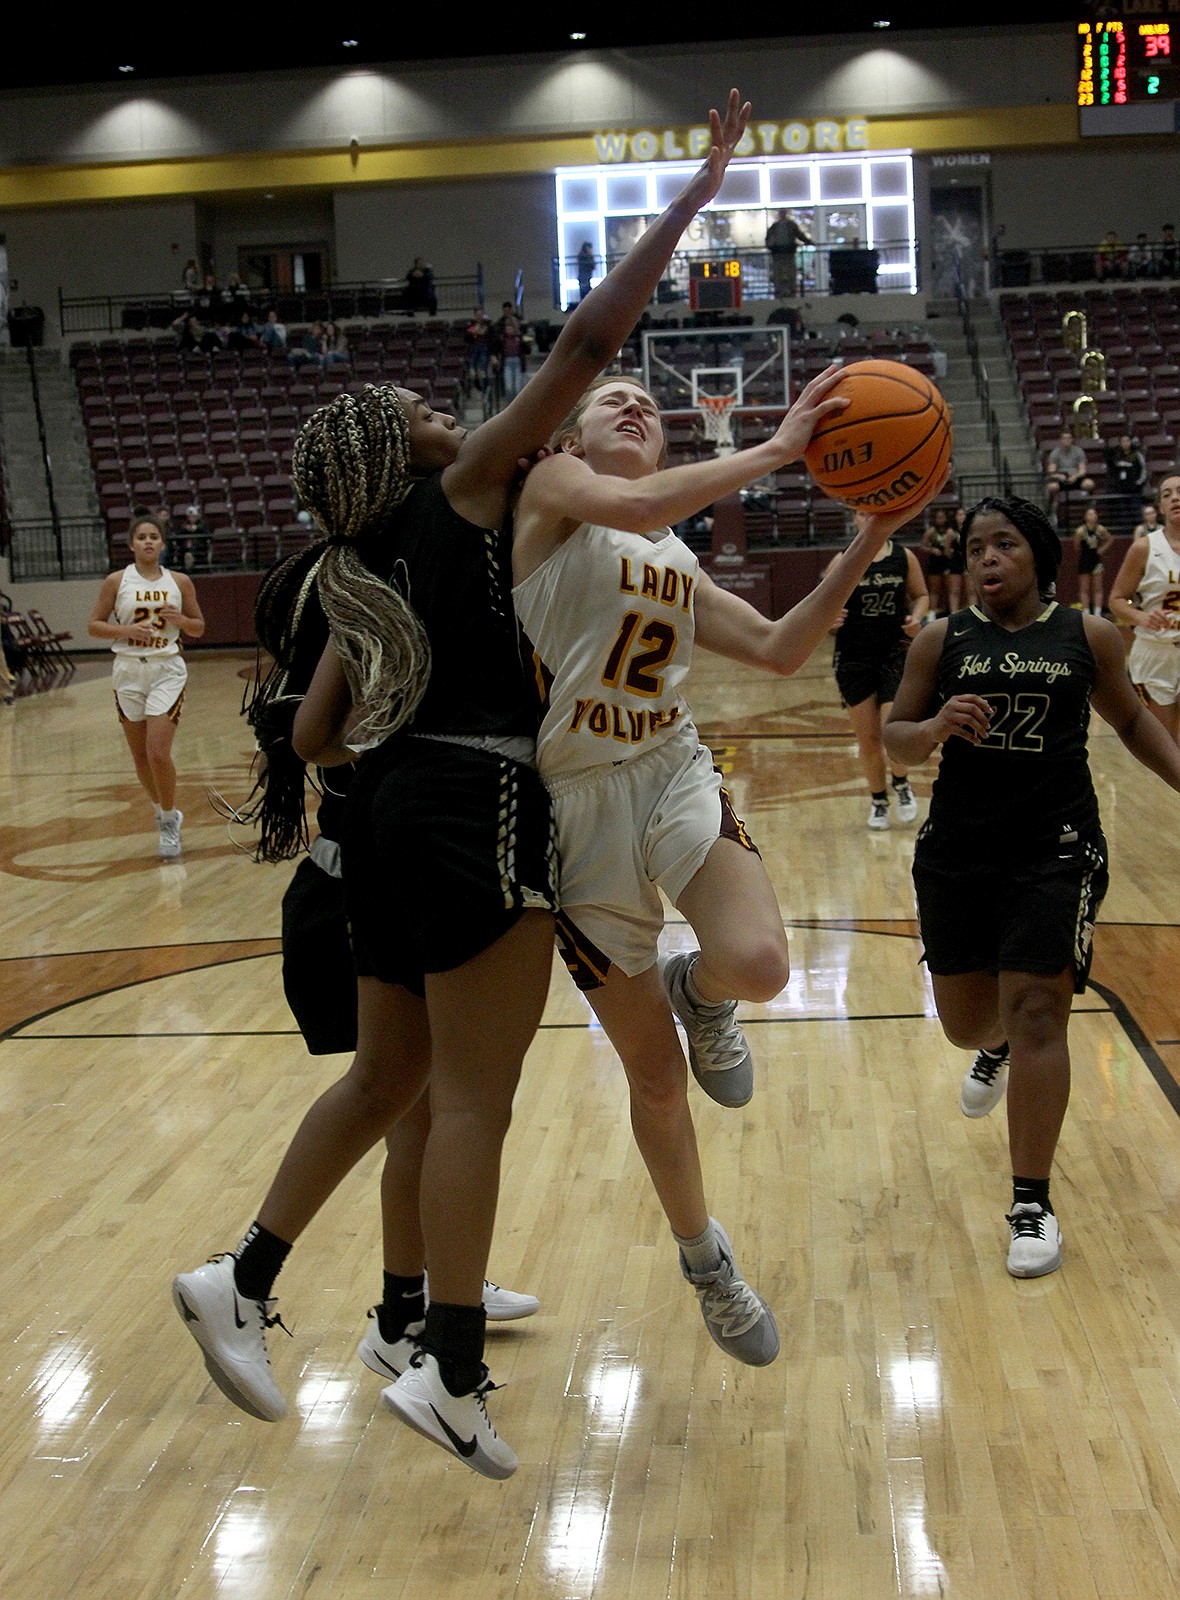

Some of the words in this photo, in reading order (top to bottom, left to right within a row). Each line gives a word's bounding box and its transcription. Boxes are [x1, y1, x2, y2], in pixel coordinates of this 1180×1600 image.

[1145, 35, 1170, 57] 39
[1148, 76, 1160, 94] 2
[593, 128, 711, 161] WOLF
[733, 118, 868, 153] STORE
[931, 153, 990, 167] WOMEN
[135, 590, 169, 602] LADY
[619, 556, 693, 613] LADY
[861, 591, 896, 616] 24
[601, 609, 678, 699] 12
[957, 653, 992, 679] Hot
[999, 652, 1072, 684] Springs
[974, 692, 1050, 752] 22
